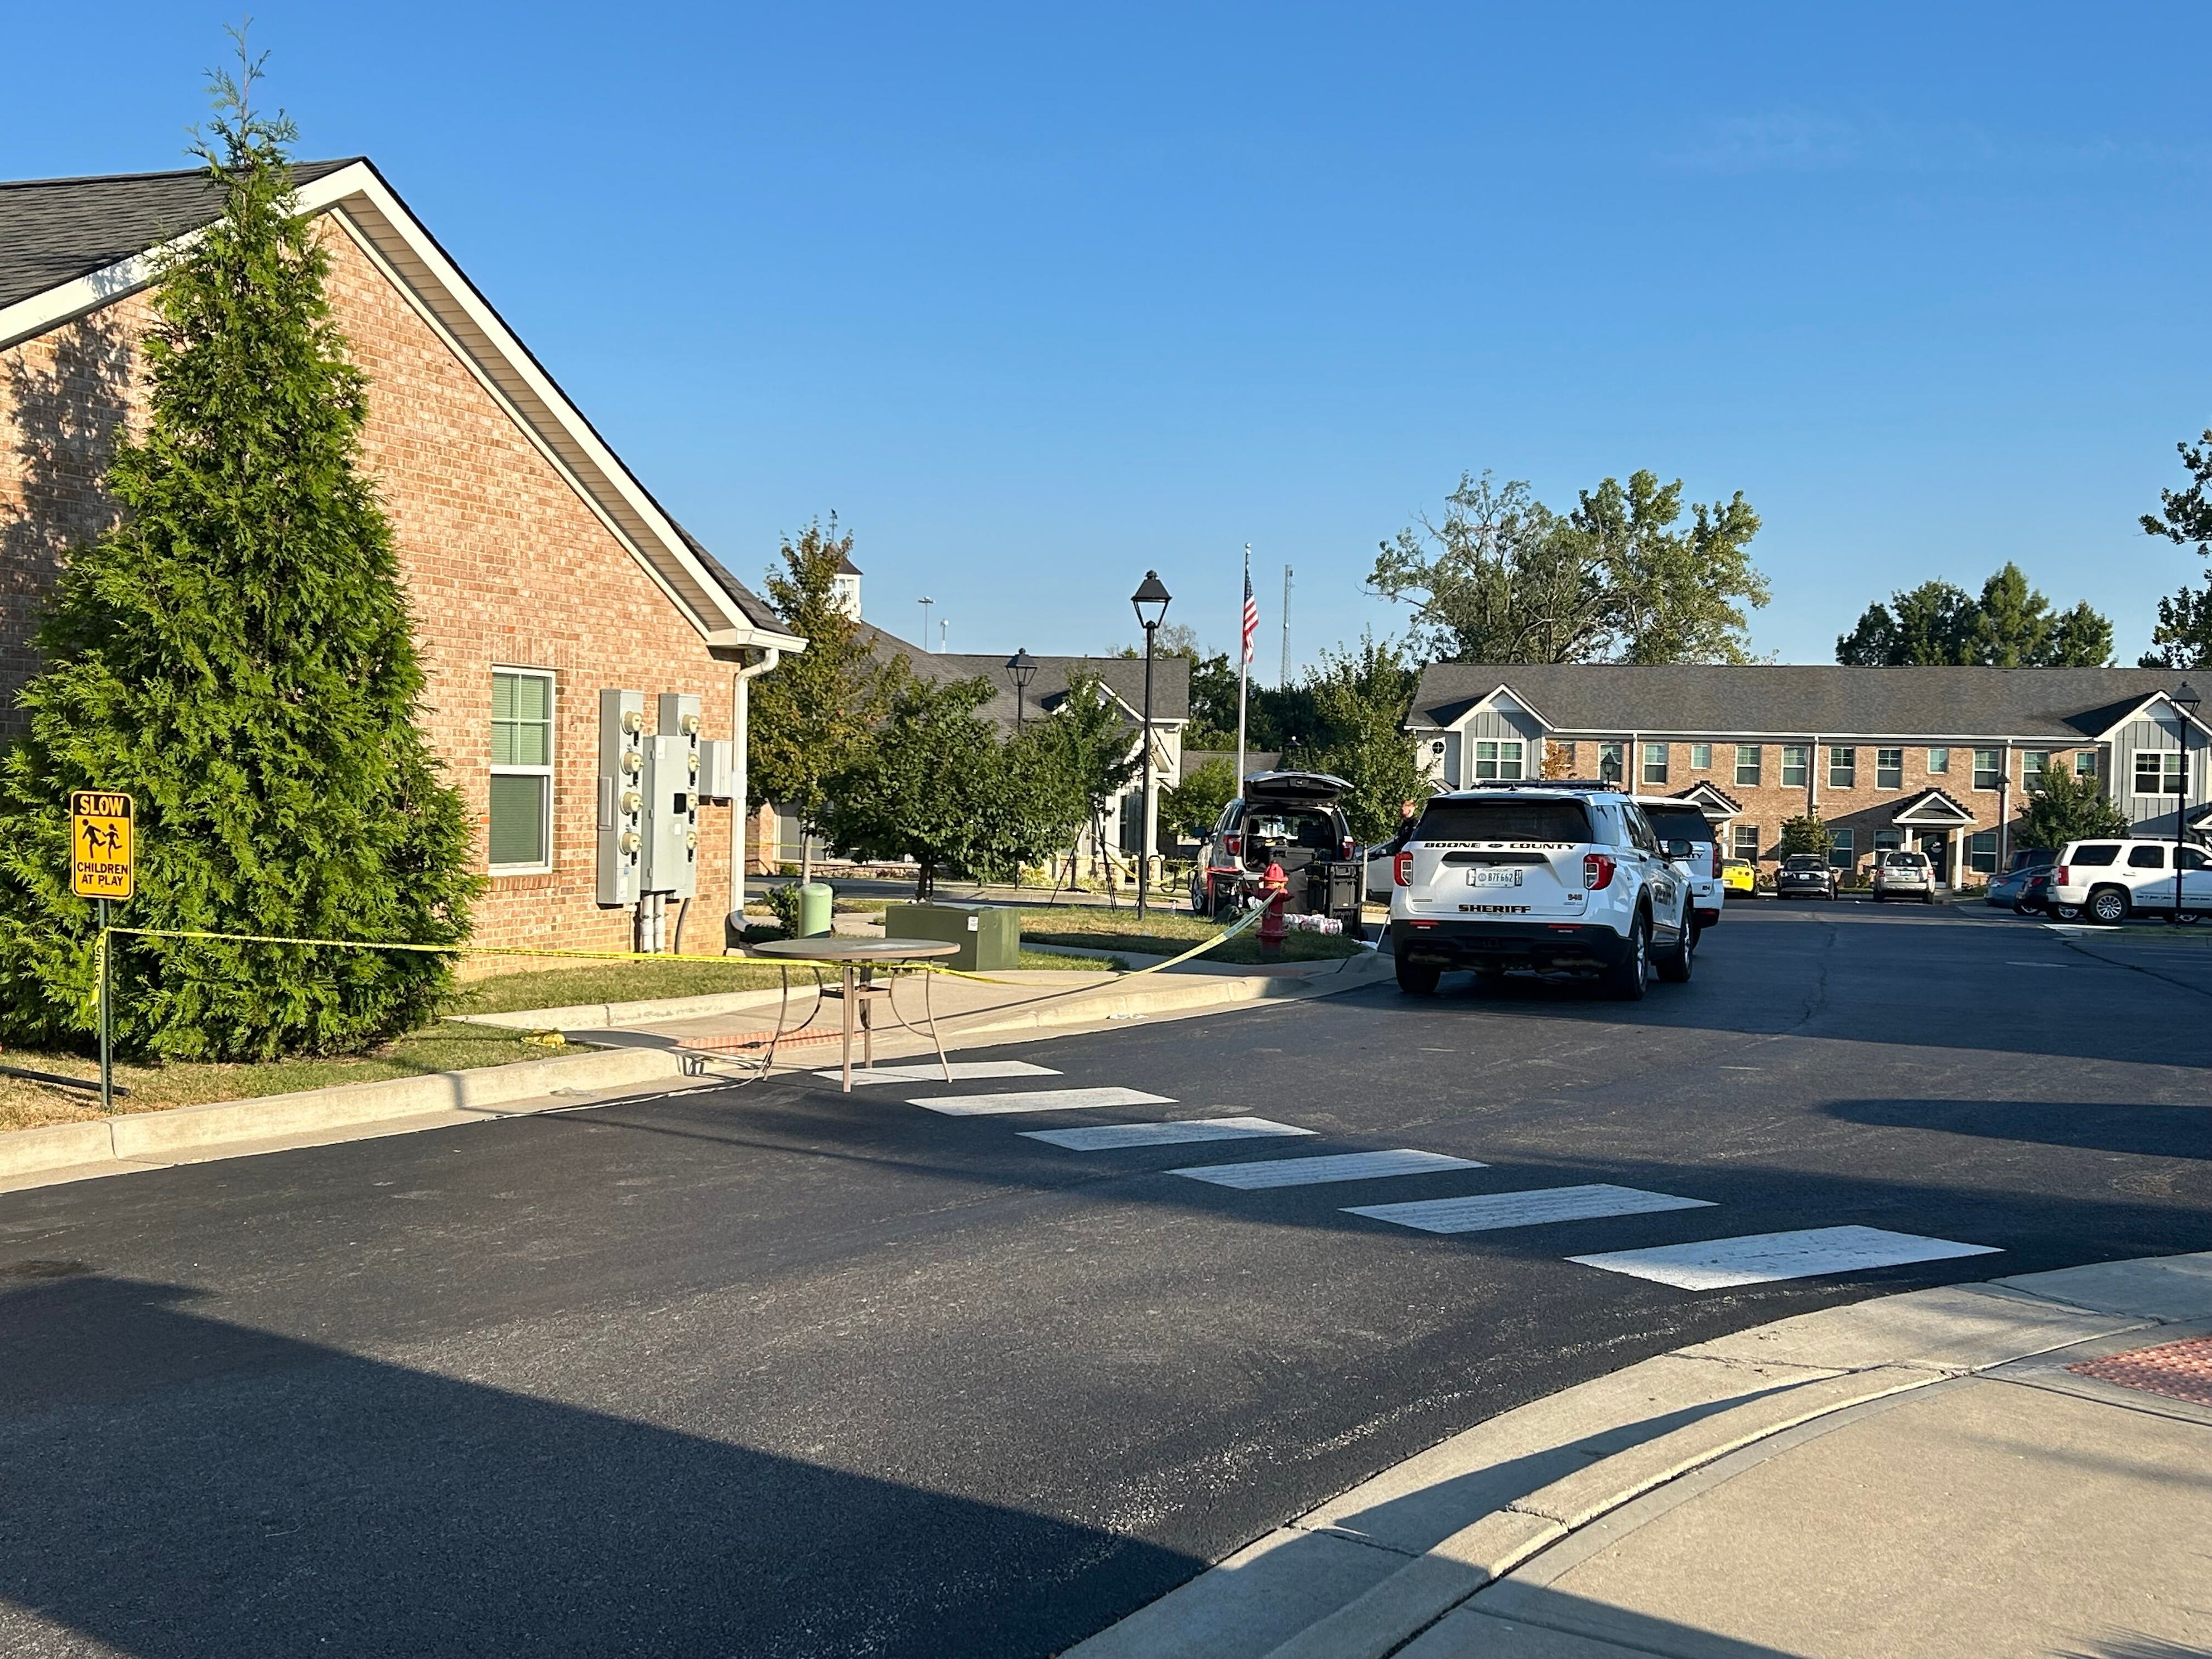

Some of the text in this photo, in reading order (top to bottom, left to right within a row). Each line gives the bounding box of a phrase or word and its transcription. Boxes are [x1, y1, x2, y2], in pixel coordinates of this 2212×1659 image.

[79, 795, 124, 816] SLOW
[77, 861, 128, 875] CHILDREN
[81, 874, 123, 886] AT PLAY
[1458, 904, 1531, 913] SHERIFF
